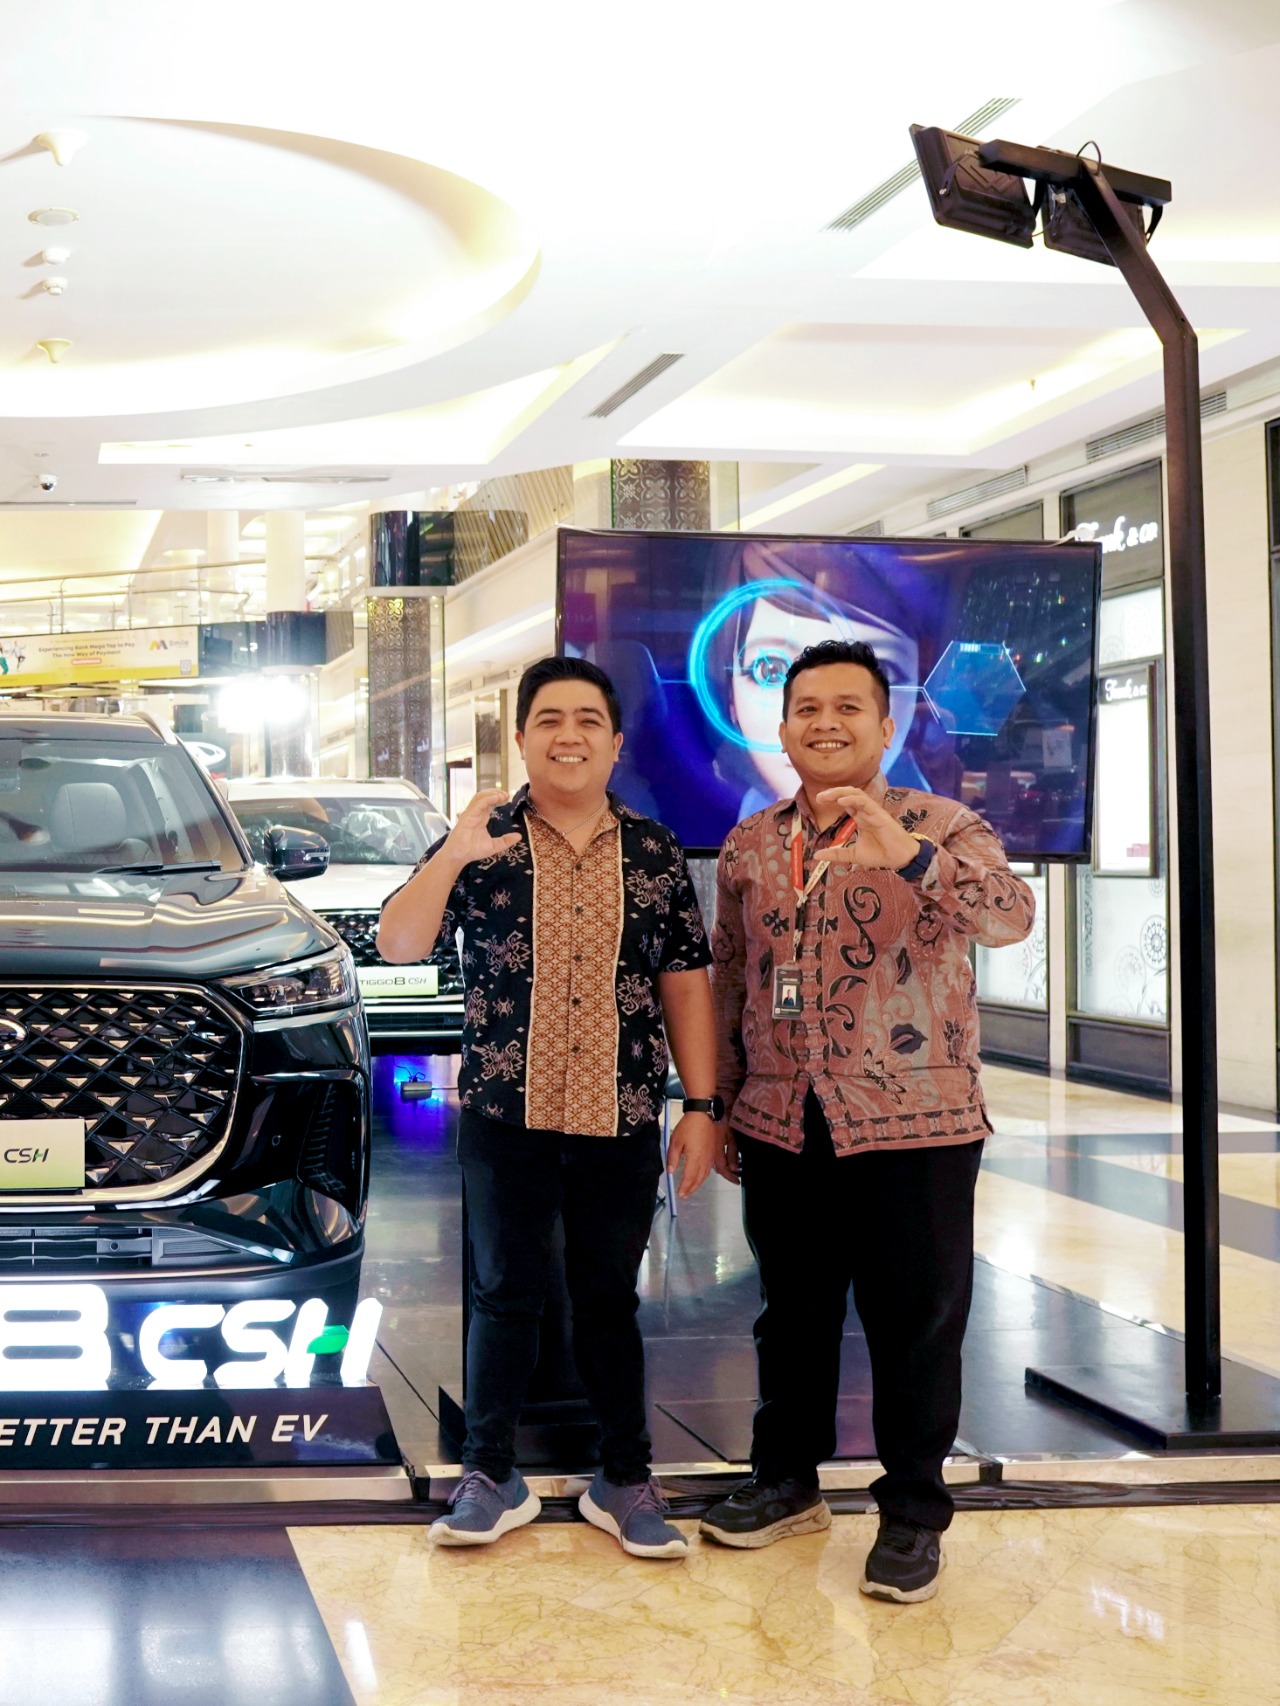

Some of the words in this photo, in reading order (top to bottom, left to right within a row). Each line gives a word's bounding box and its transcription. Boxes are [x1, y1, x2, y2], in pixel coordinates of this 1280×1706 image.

[96, 649, 121, 657] Payment
[4, 1147, 49, 1163] CSH
[138, 1297, 383, 1390] CSH
[146, 1415, 258, 1445] THAN
[271, 1414, 329, 1443] EV
